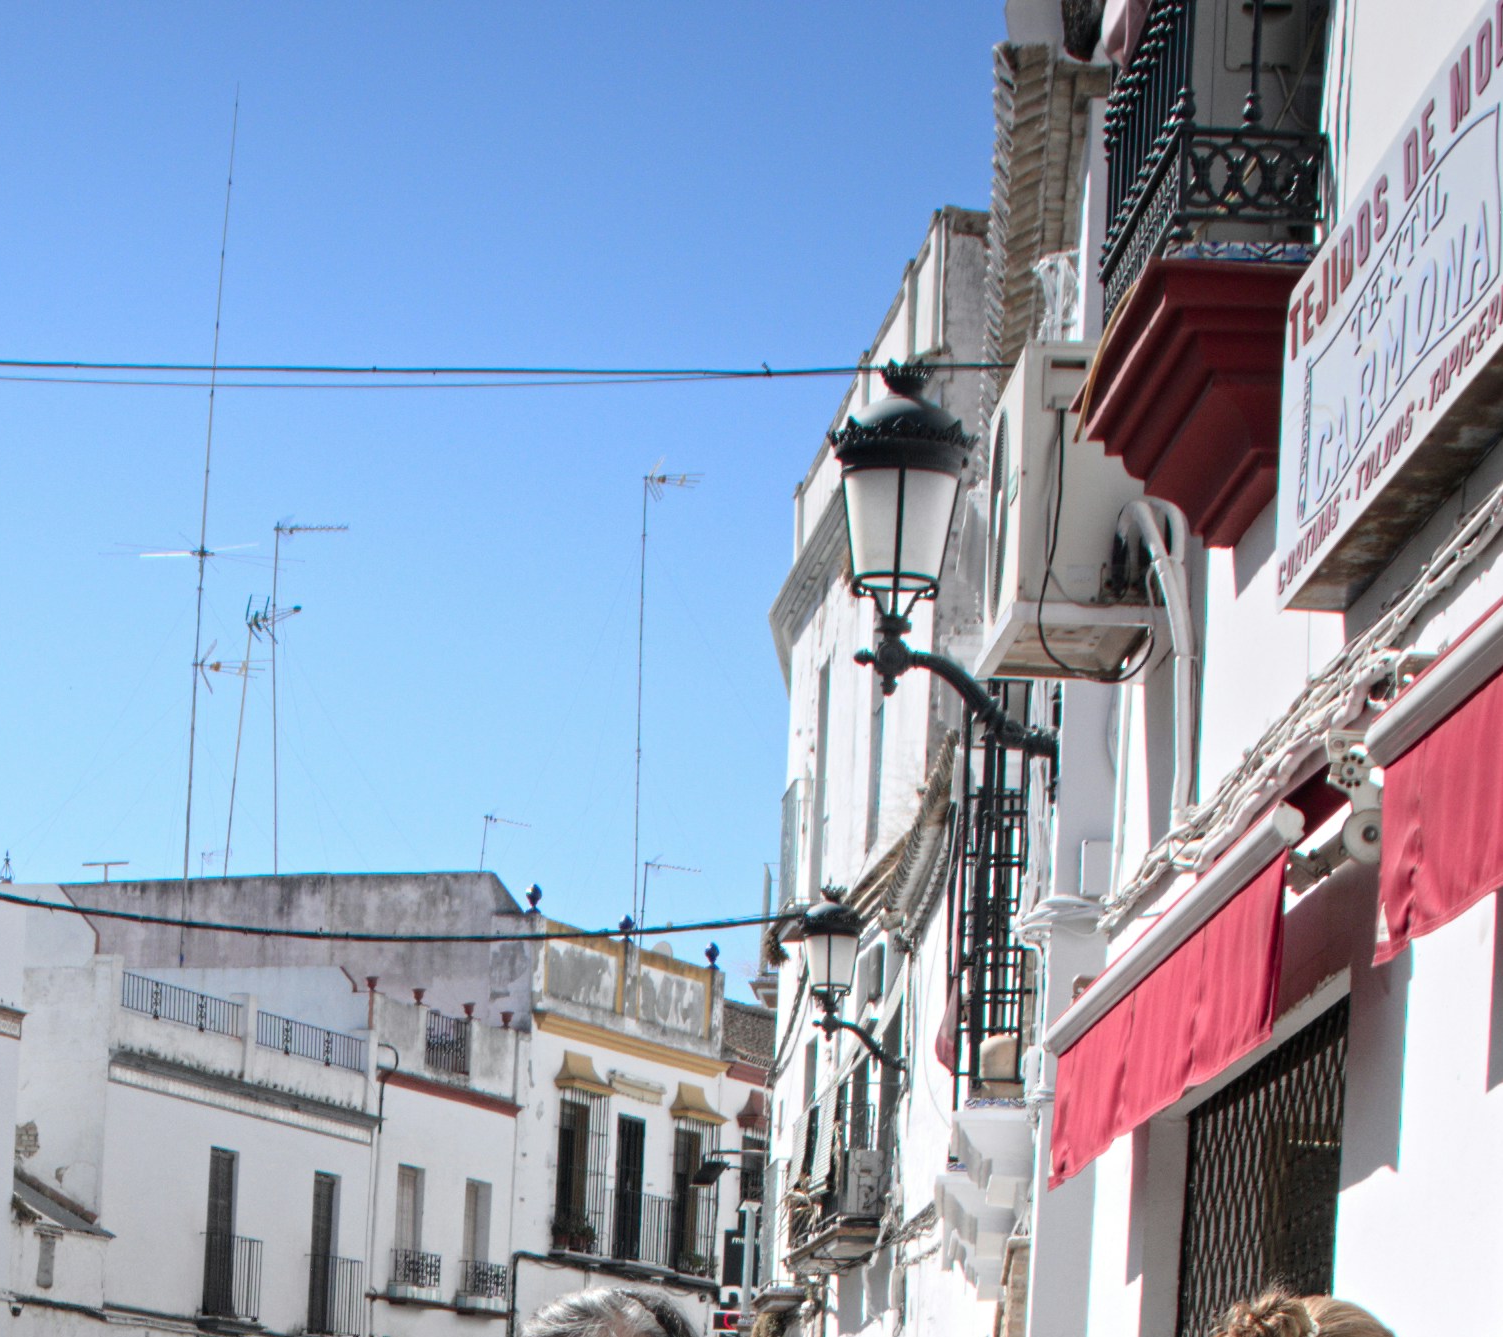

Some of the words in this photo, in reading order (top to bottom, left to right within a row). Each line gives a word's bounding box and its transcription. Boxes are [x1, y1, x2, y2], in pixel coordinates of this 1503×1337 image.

[1288, 174, 1388, 361] TEJIDOS
[1403, 98, 1436, 202] DE
[1350, 172, 1449, 356] TEXTIL
[1311, 200, 1491, 504] CARMONA
[1277, 497, 1342, 596] CORTINAS
[1354, 401, 1415, 502] TOLDOS
